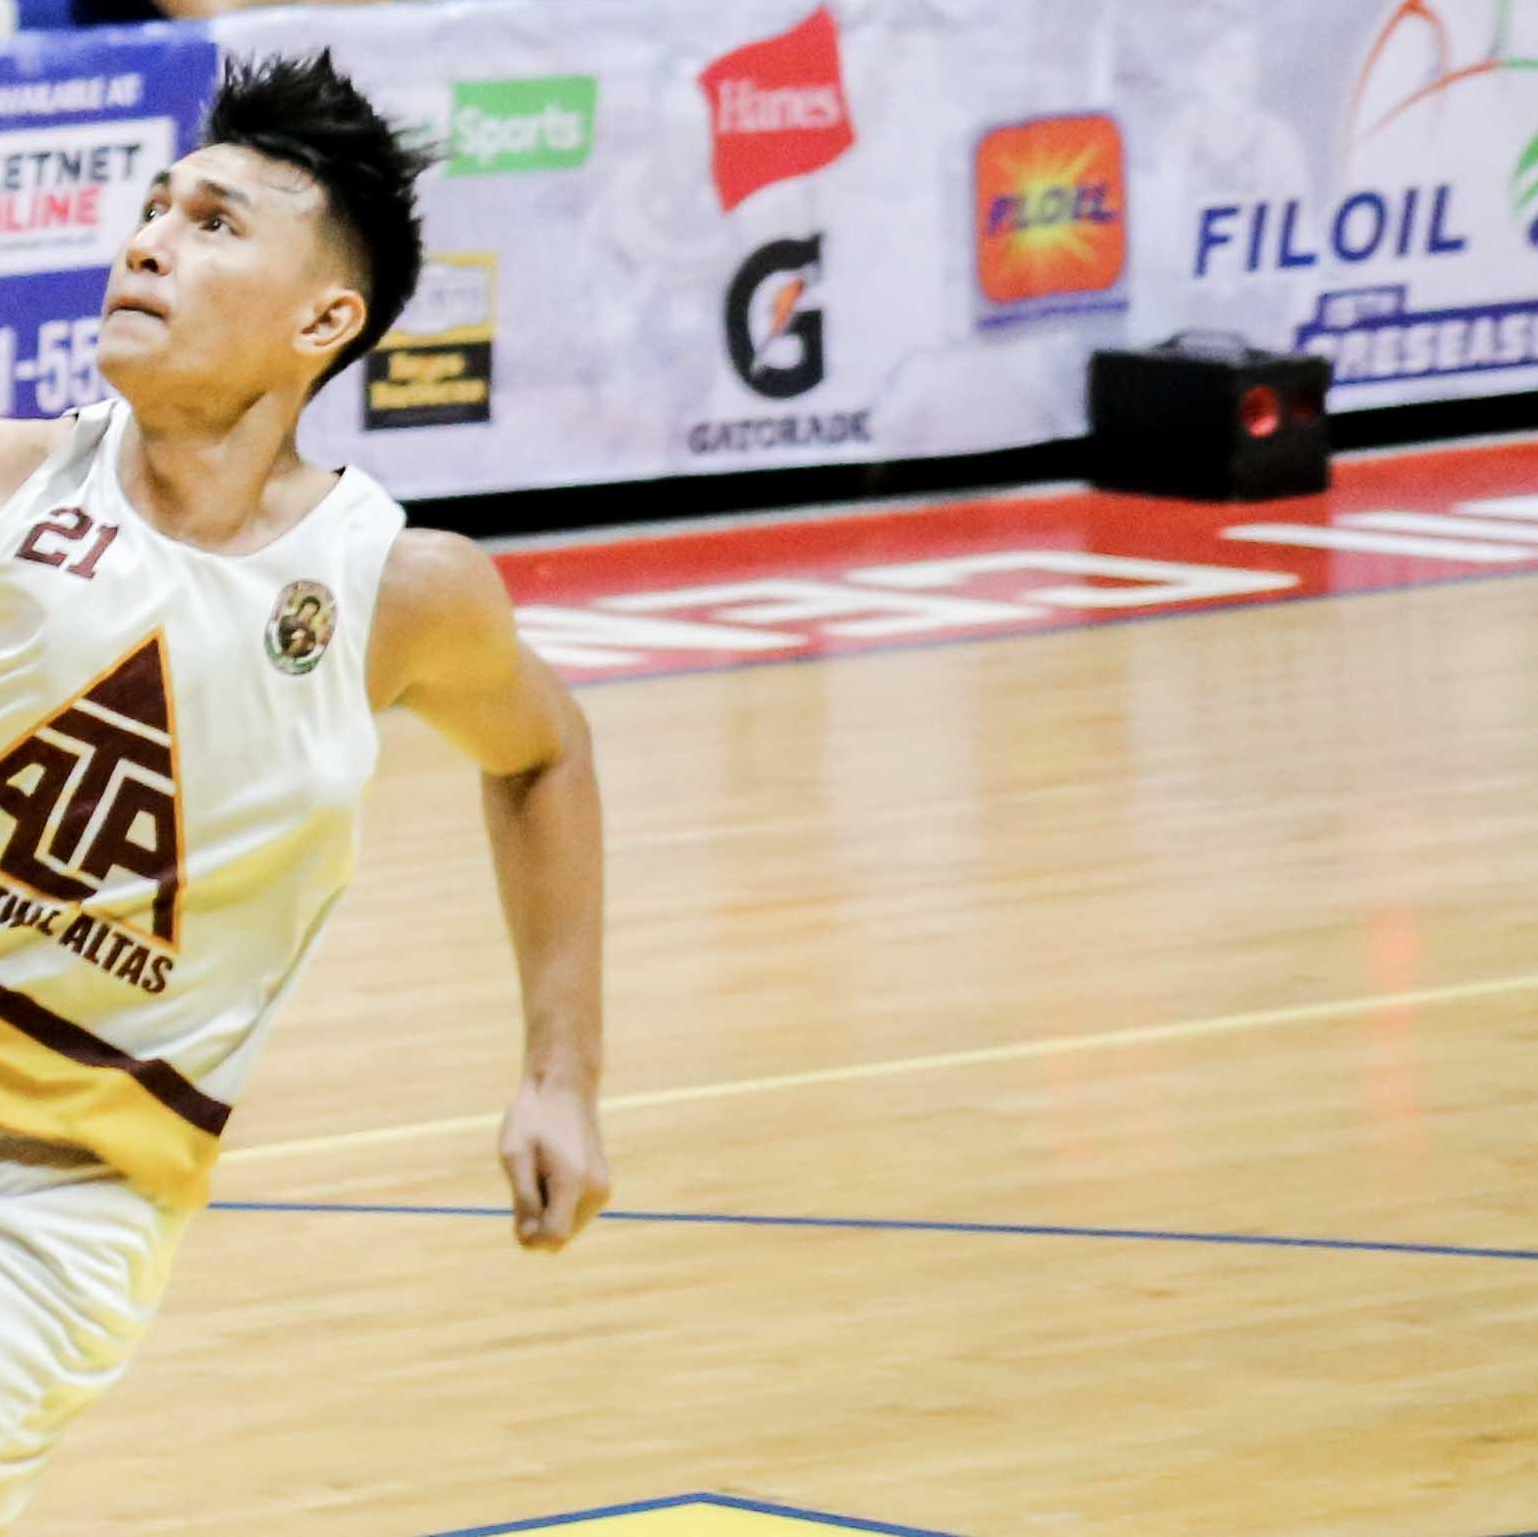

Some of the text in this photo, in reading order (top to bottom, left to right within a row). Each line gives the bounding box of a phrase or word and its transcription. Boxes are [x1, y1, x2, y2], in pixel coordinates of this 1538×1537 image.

[455, 102, 583, 167] Sports
[716, 79, 841, 134] Hanes
[1192, 184, 1467, 280] FILOIL
[688, 409, 873, 456] GATORADE
[14, 505, 121, 582] 21
[58, 912, 175, 994] ALTAS
